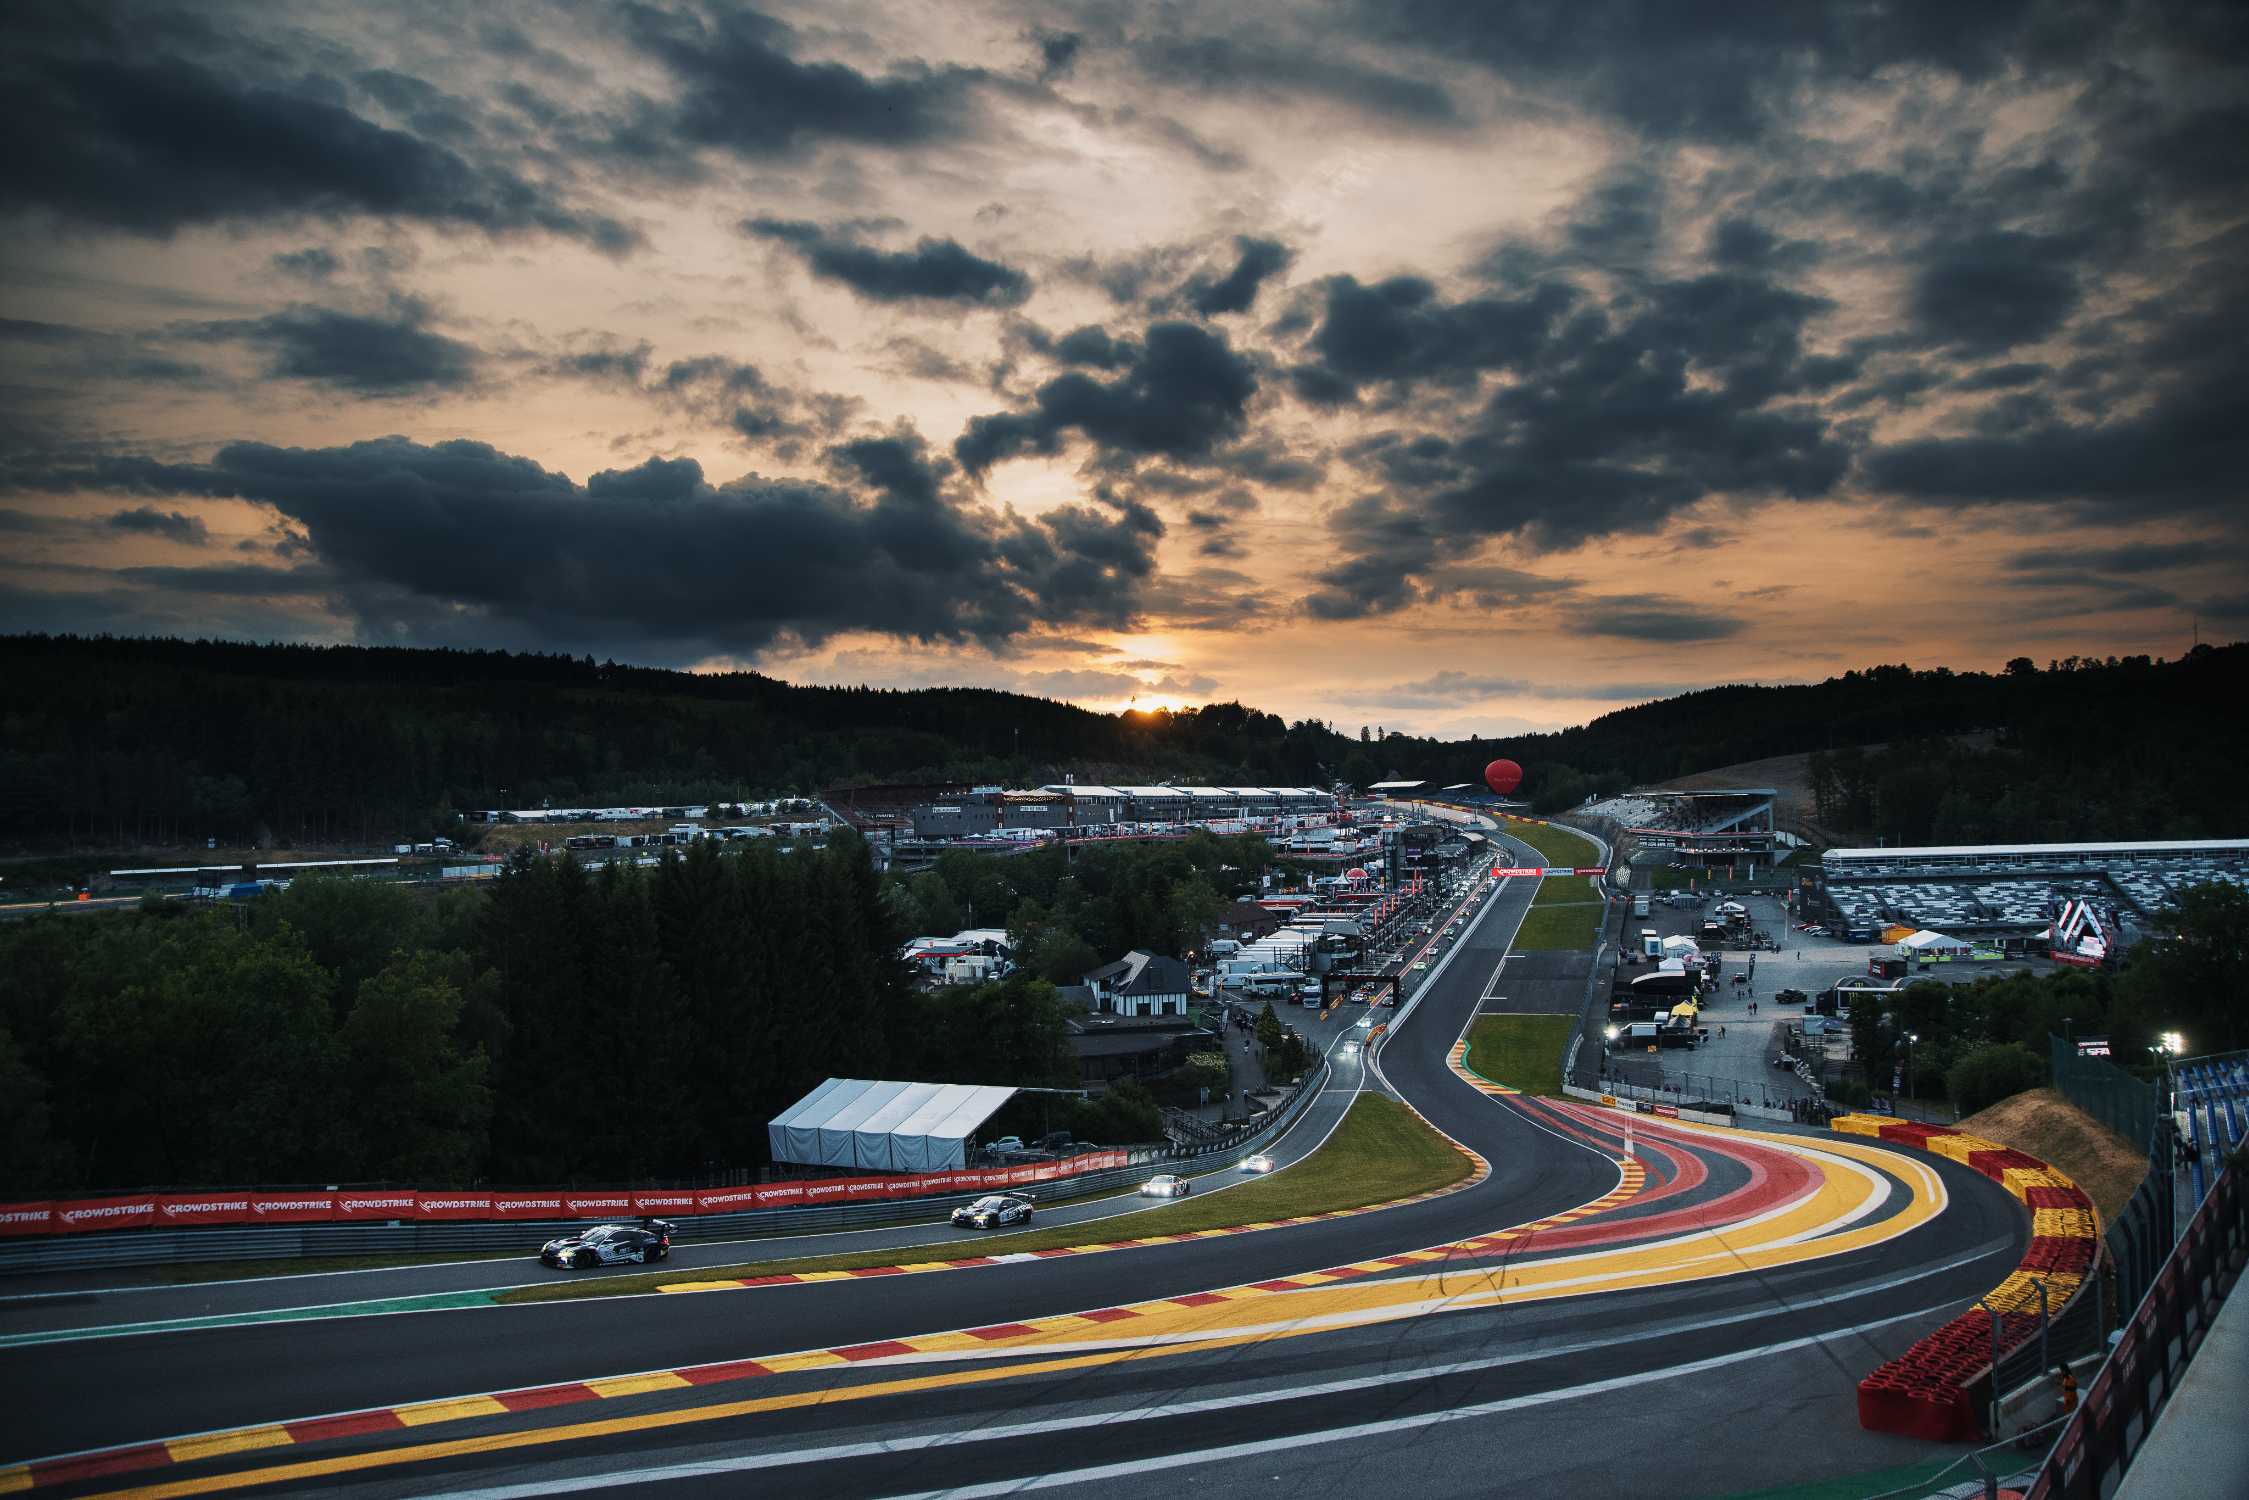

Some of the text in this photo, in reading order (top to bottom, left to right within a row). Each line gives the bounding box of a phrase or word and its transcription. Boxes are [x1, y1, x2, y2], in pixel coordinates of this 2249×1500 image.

[702, 1192, 752, 1205] CROWDSTRIKE
[759, 1187, 803, 1200] CROWDSTRIKE
[257, 1200, 332, 1211] CROWDSTRIKE
[344, 1198, 414, 1209] CROWDSTRIKE
[424, 1199, 491, 1209] CROWDSTRIKE
[499, 1199, 561, 1209] CROWDSTRIKE
[571, 1199, 629, 1208] CROWDSTRIKE
[638, 1197, 693, 1206] CROWDSTRIKE
[66, 1203, 155, 1220] CROWDSTRIKE
[167, 1201, 248, 1214] CROWDSTRIKE
